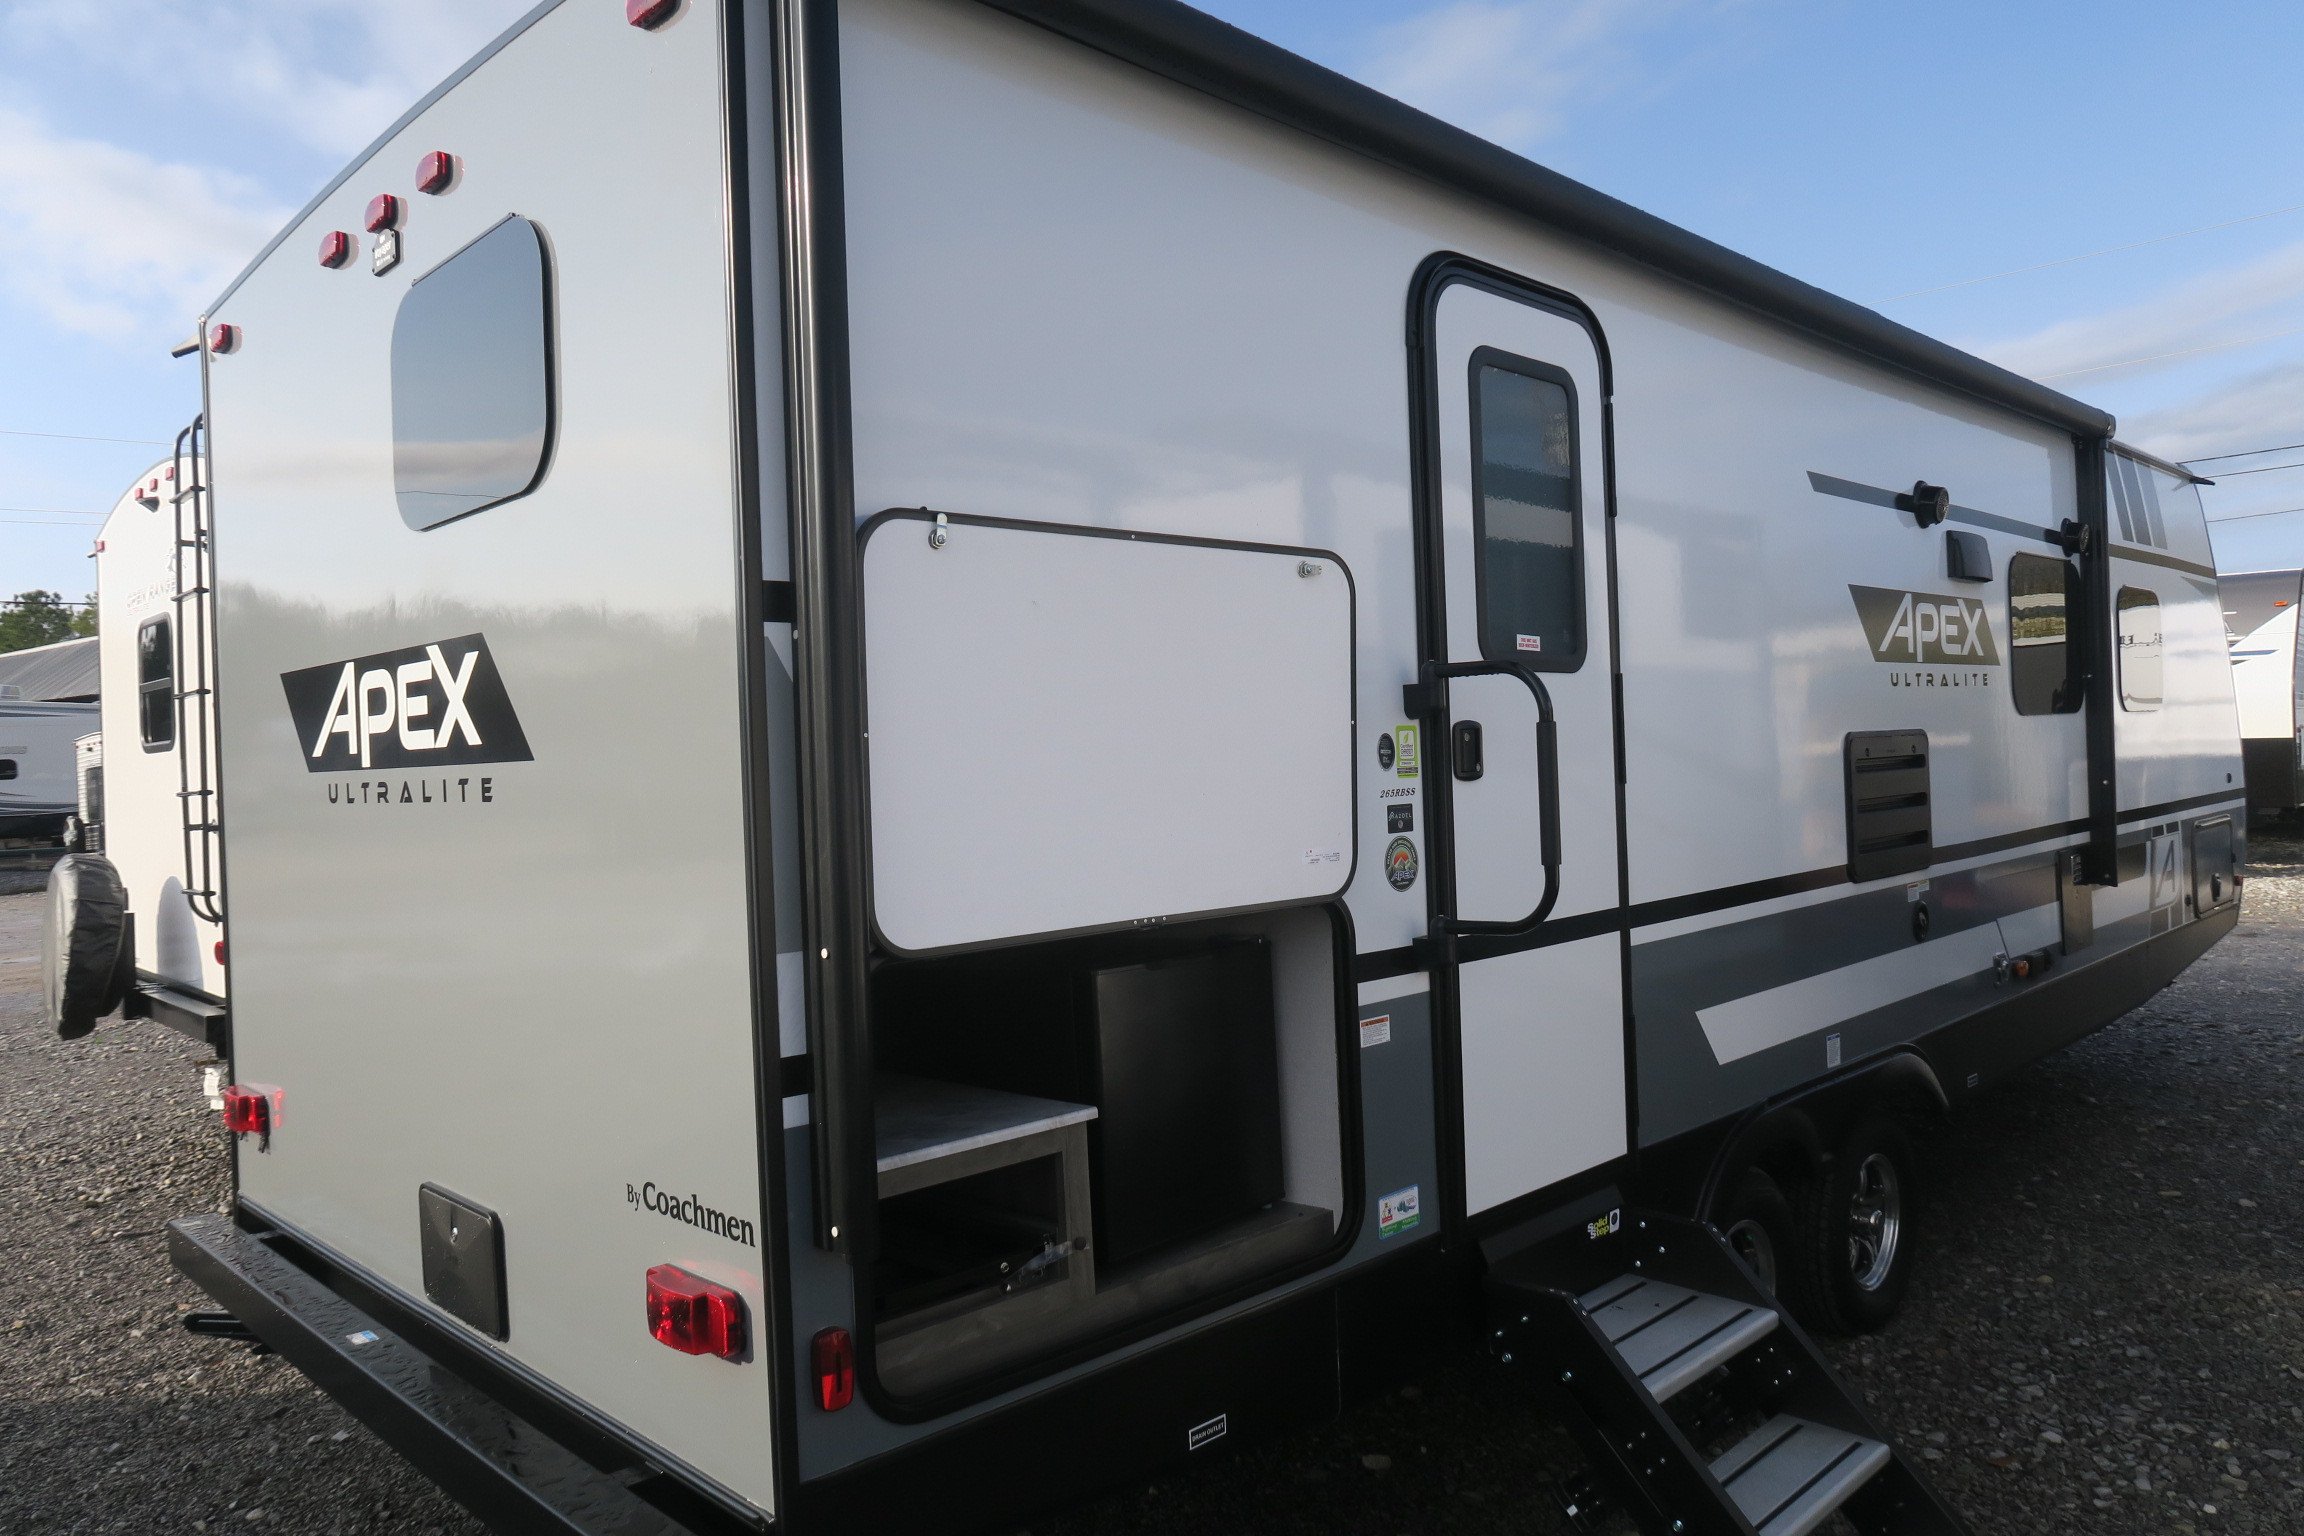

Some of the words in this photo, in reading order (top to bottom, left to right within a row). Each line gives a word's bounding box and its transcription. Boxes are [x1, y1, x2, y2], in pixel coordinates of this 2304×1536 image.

[1879, 593, 1984, 662] APEX
[1890, 673, 1988, 687] ULTRALITE
[312, 645, 483, 768] APEX
[328, 777, 493, 804] ULTRALITE
[1380, 788, 1416, 798] 265RBSS
[1391, 870, 1416, 882] APEX
[626, 1182, 641, 1212] By
[642, 1181, 756, 1248] Coachmen
[1207, 1421, 1224, 1435] OUTLET
